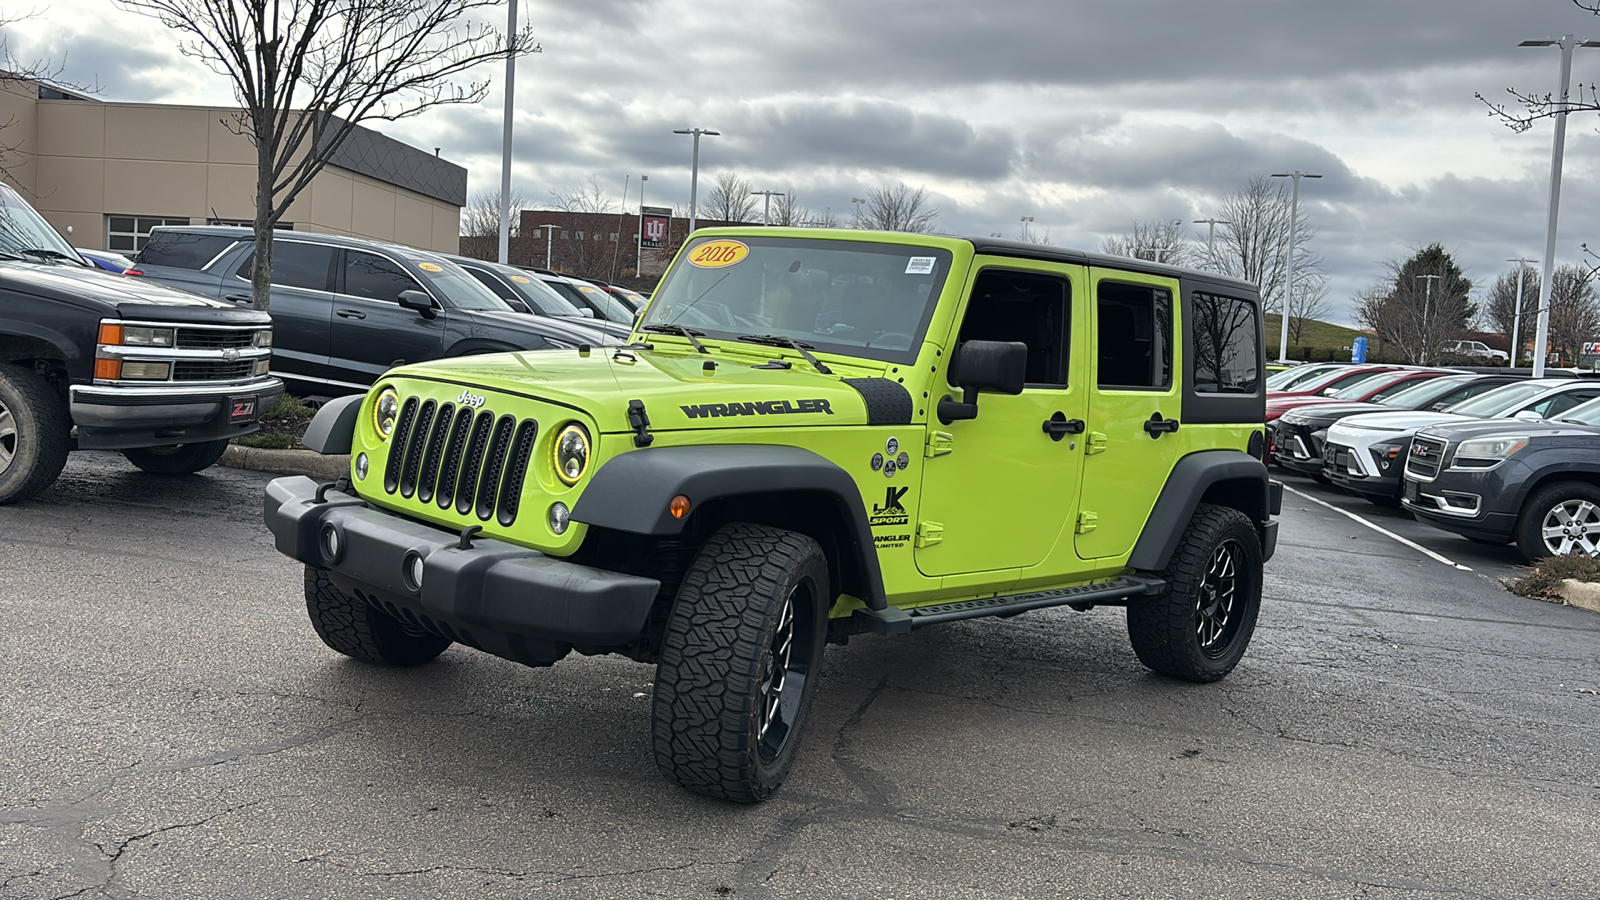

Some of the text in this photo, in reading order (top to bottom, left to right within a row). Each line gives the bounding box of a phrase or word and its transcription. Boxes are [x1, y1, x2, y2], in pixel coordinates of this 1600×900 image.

[694, 245, 742, 262] 2016
[457, 389, 486, 409] Jeep
[232, 402, 255, 417] Z71
[679, 398, 835, 419] WRANGLER
[873, 486, 909, 515] JK
[870, 517, 907, 525] SPORT
[874, 534, 911, 542] ANGLER
